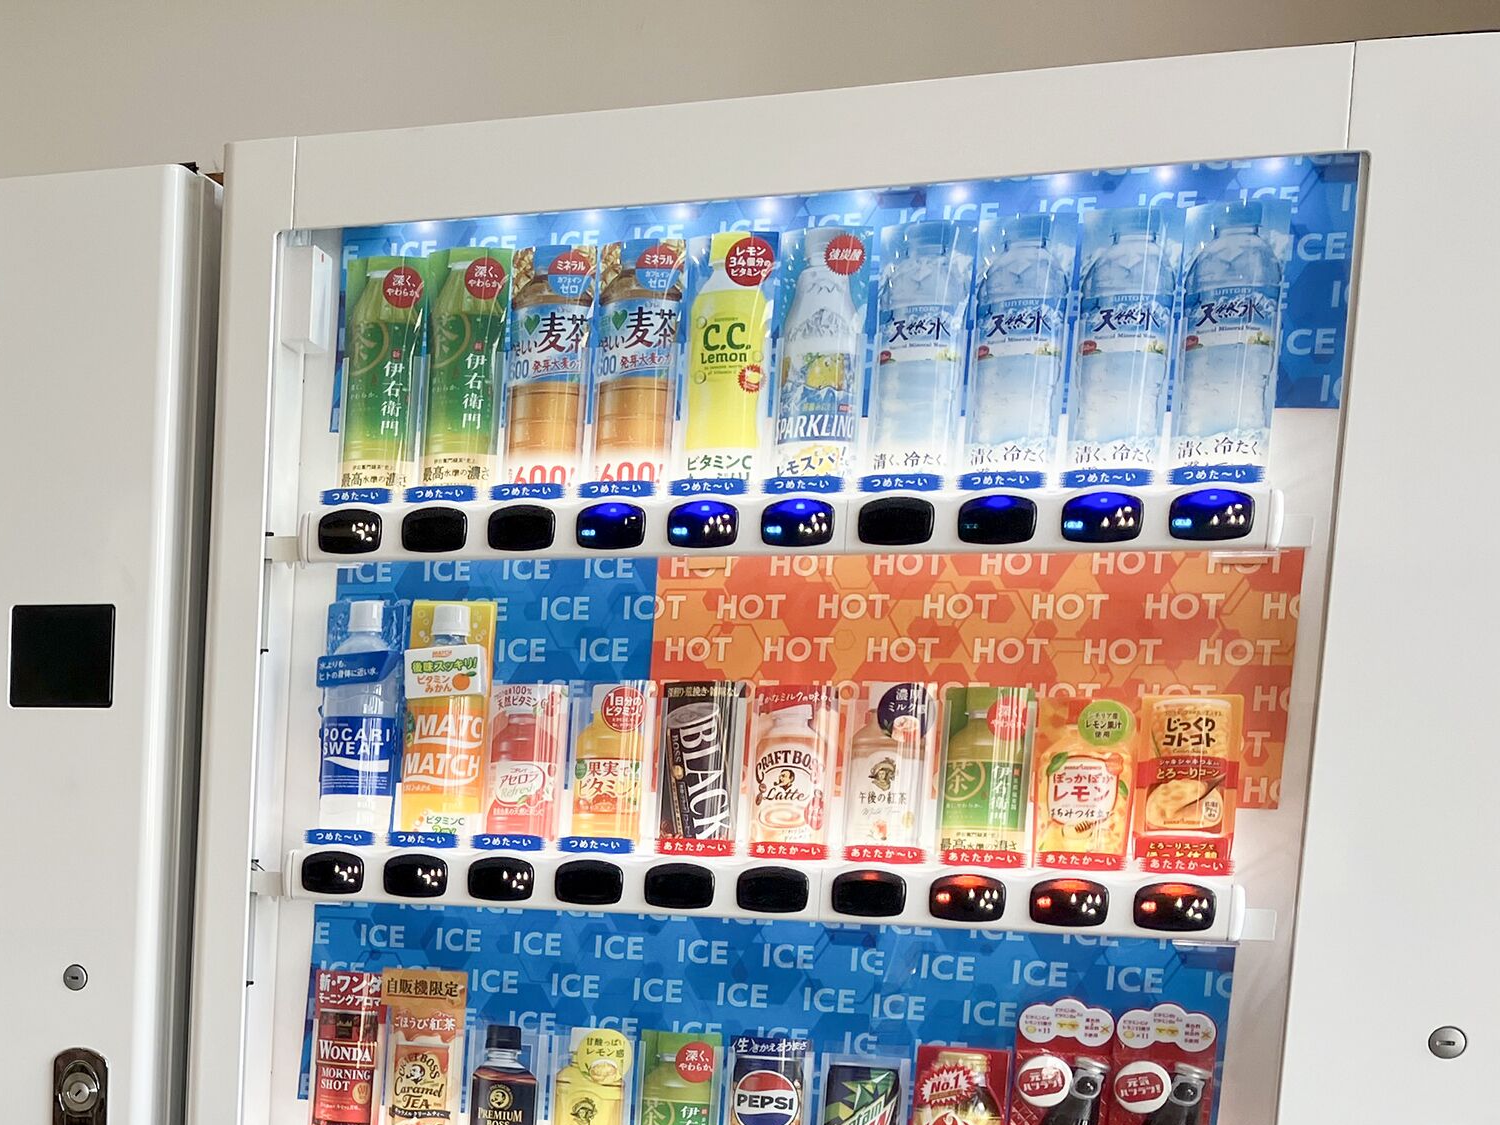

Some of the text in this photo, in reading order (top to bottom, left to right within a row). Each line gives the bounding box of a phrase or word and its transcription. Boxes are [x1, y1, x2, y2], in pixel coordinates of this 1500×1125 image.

[735, 246, 766, 256] レモン
[828, 248, 863, 262] 強炭酸
[556, 261, 586, 271] ミネラル
[559, 284, 578, 294] ゼロ
[1195, 298, 1264, 327] 天然水
[626, 307, 677, 349] 麦茶
[703, 323, 752, 352] C.C.
[700, 352, 747, 365] Lemon
[381, 361, 404, 437] 伊右衛門
[462, 353, 487, 430] 伊右衛門
[777, 414, 854, 439] SPARKLING
[687, 455, 752, 472] ビタミンC
[541, 596, 590, 621] ICE
[717, 594, 786, 619] HOT
[1032, 594, 1109, 620] HOT
[580, 638, 628, 662] ICE
[763, 637, 835, 662] HOT
[425, 683, 452, 693] みかん
[323, 727, 390, 742] POCARI
[1166, 717, 1216, 734] じっくり
[1163, 732, 1216, 748] コトコト
[323, 742, 382, 757] SWEAT
[404, 754, 481, 776] MATCH
[678, 714, 730, 839] BLACK
[762, 787, 810, 802] Latte
[859, 791, 908, 804] 午後の紅茶
[360, 924, 405, 948] ICE
[513, 930, 562, 956] ICE
[386, 978, 459, 998] 自販機限定
[717, 982, 769, 1008] ICE
[319, 992, 381, 1006] モーニングアロマ
[395, 1016, 456, 1030] ごほうび紅茶
[319, 1039, 373, 1063] WONDA
[321, 1067, 371, 1081] MORNING
[321, 1079, 350, 1091] SHOT
[394, 1076, 444, 1098] Caramel
[930, 1075, 962, 1094] No.1
[403, 1095, 431, 1109] TEA
[737, 1094, 795, 1112] PEPSI
[478, 1107, 522, 1123] PREMIUM
